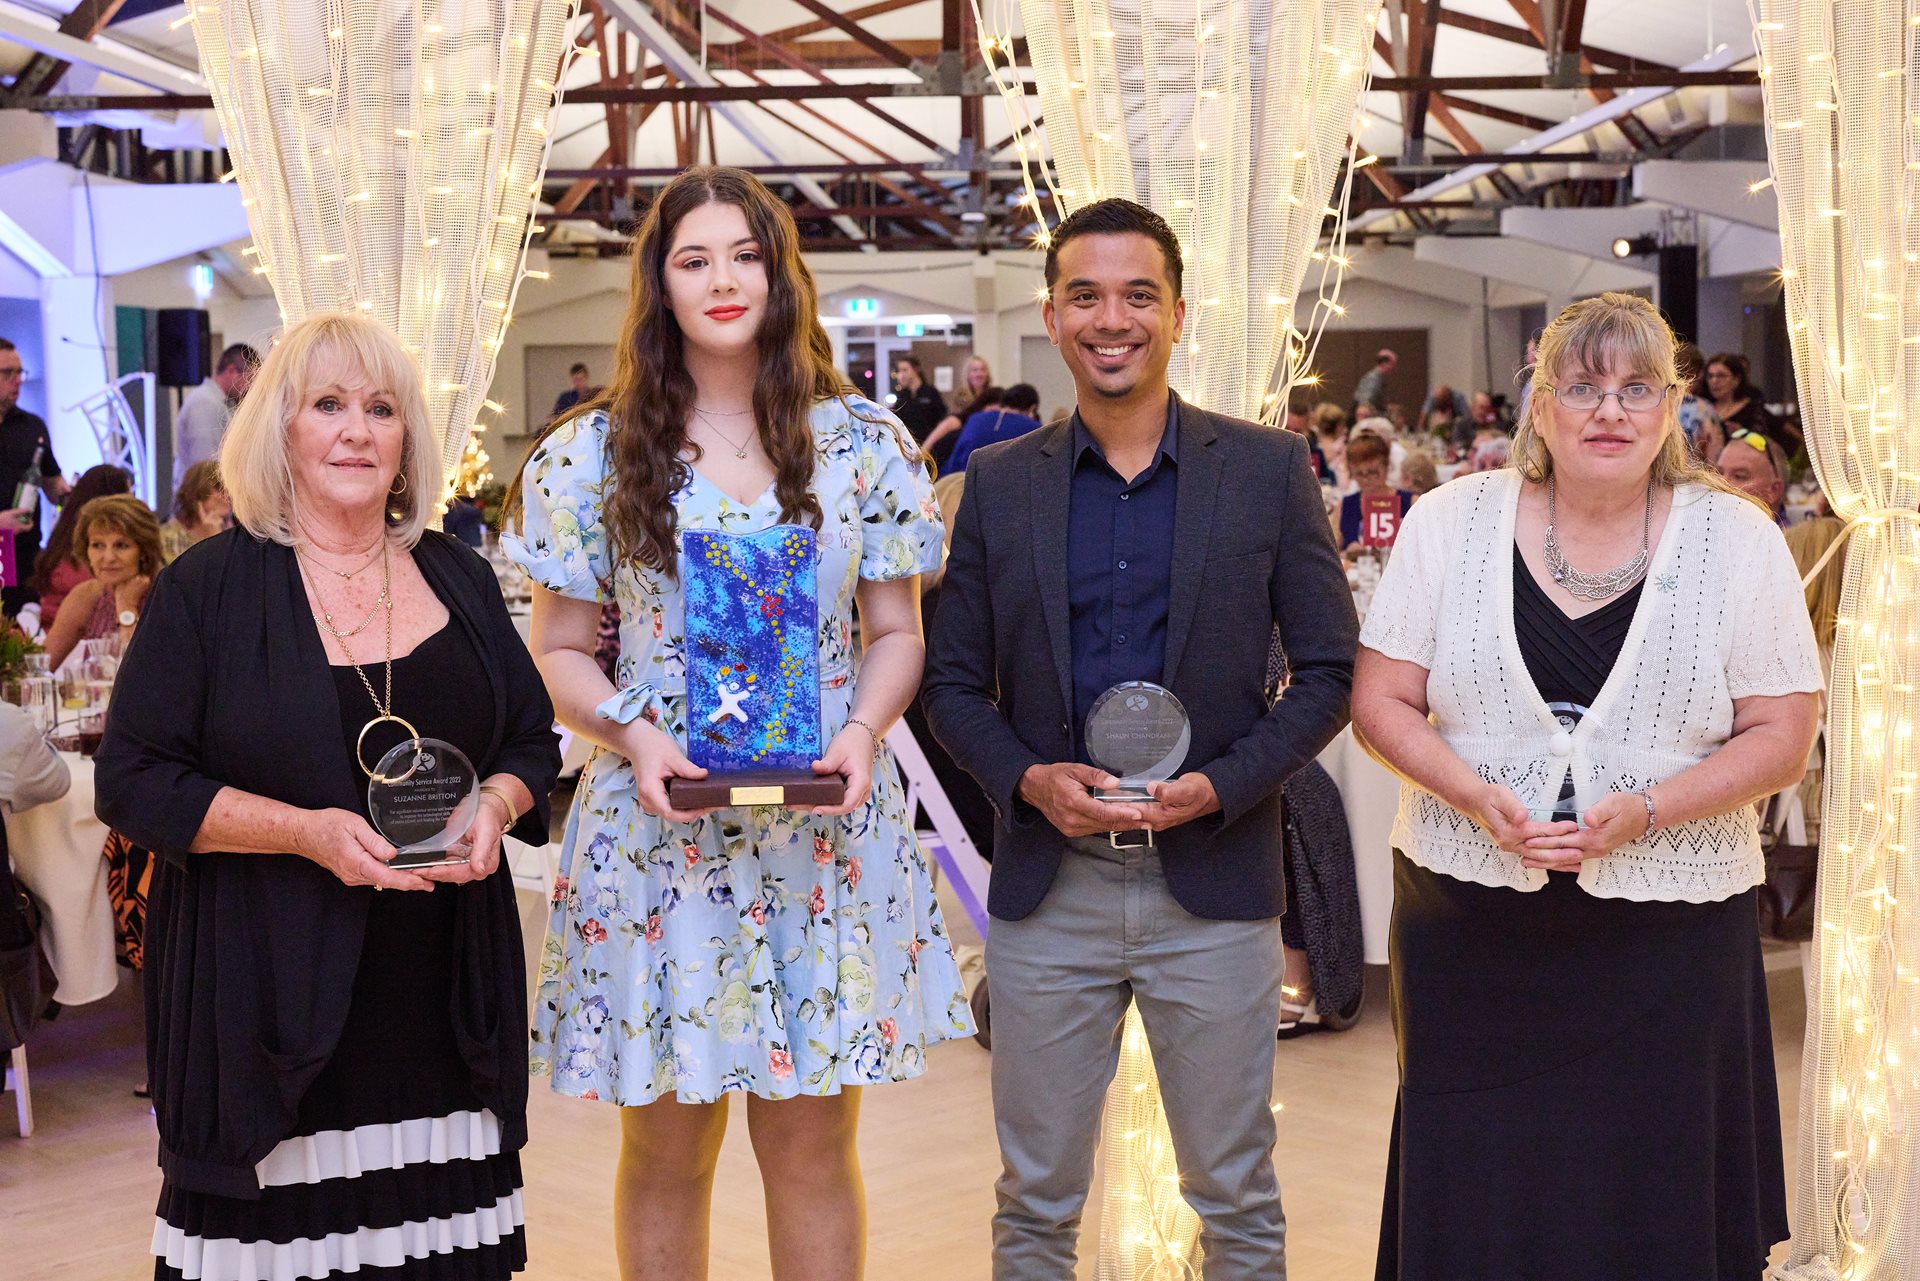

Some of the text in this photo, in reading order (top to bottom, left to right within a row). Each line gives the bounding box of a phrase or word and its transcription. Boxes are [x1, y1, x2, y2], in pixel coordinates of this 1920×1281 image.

[1369, 512, 1395, 539] 15
[415, 778, 432, 786] Service
[433, 776, 449, 785] Award
[449, 775, 461, 784] 2022
[393, 792, 457, 803] SUZANNE BRITTON
